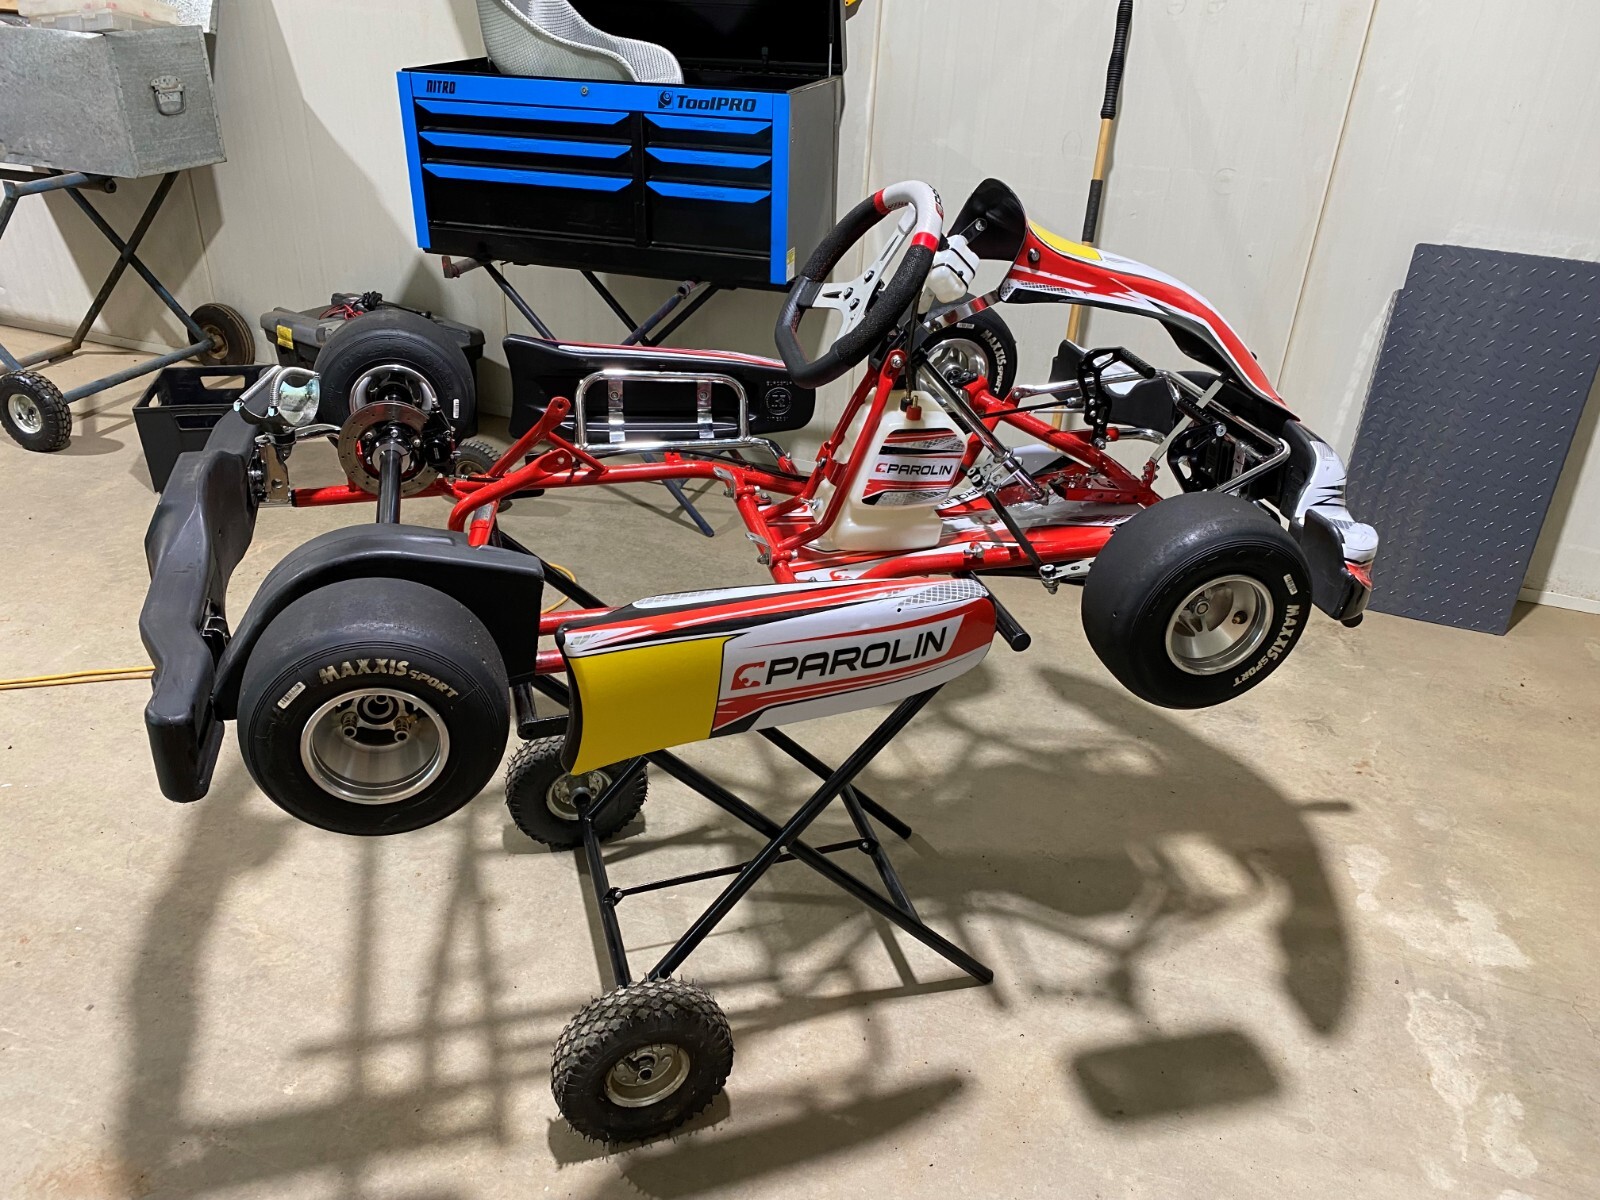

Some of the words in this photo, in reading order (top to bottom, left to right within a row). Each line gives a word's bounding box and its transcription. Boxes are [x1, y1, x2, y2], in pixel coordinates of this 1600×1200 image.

[426, 79, 456, 94] NITRO
[677, 95, 757, 112] ToolPRO
[980, 329, 1007, 365] MAXXIS
[993, 365, 1004, 395] SPORT
[887, 463, 954, 476] PAROLIN
[1268, 604, 1301, 661] MAXXIS
[765, 626, 948, 685] PAROLIN
[318, 658, 410, 685] MAXXIS
[408, 669, 459, 699] SPORT
[1233, 657, 1269, 687] SPORT
